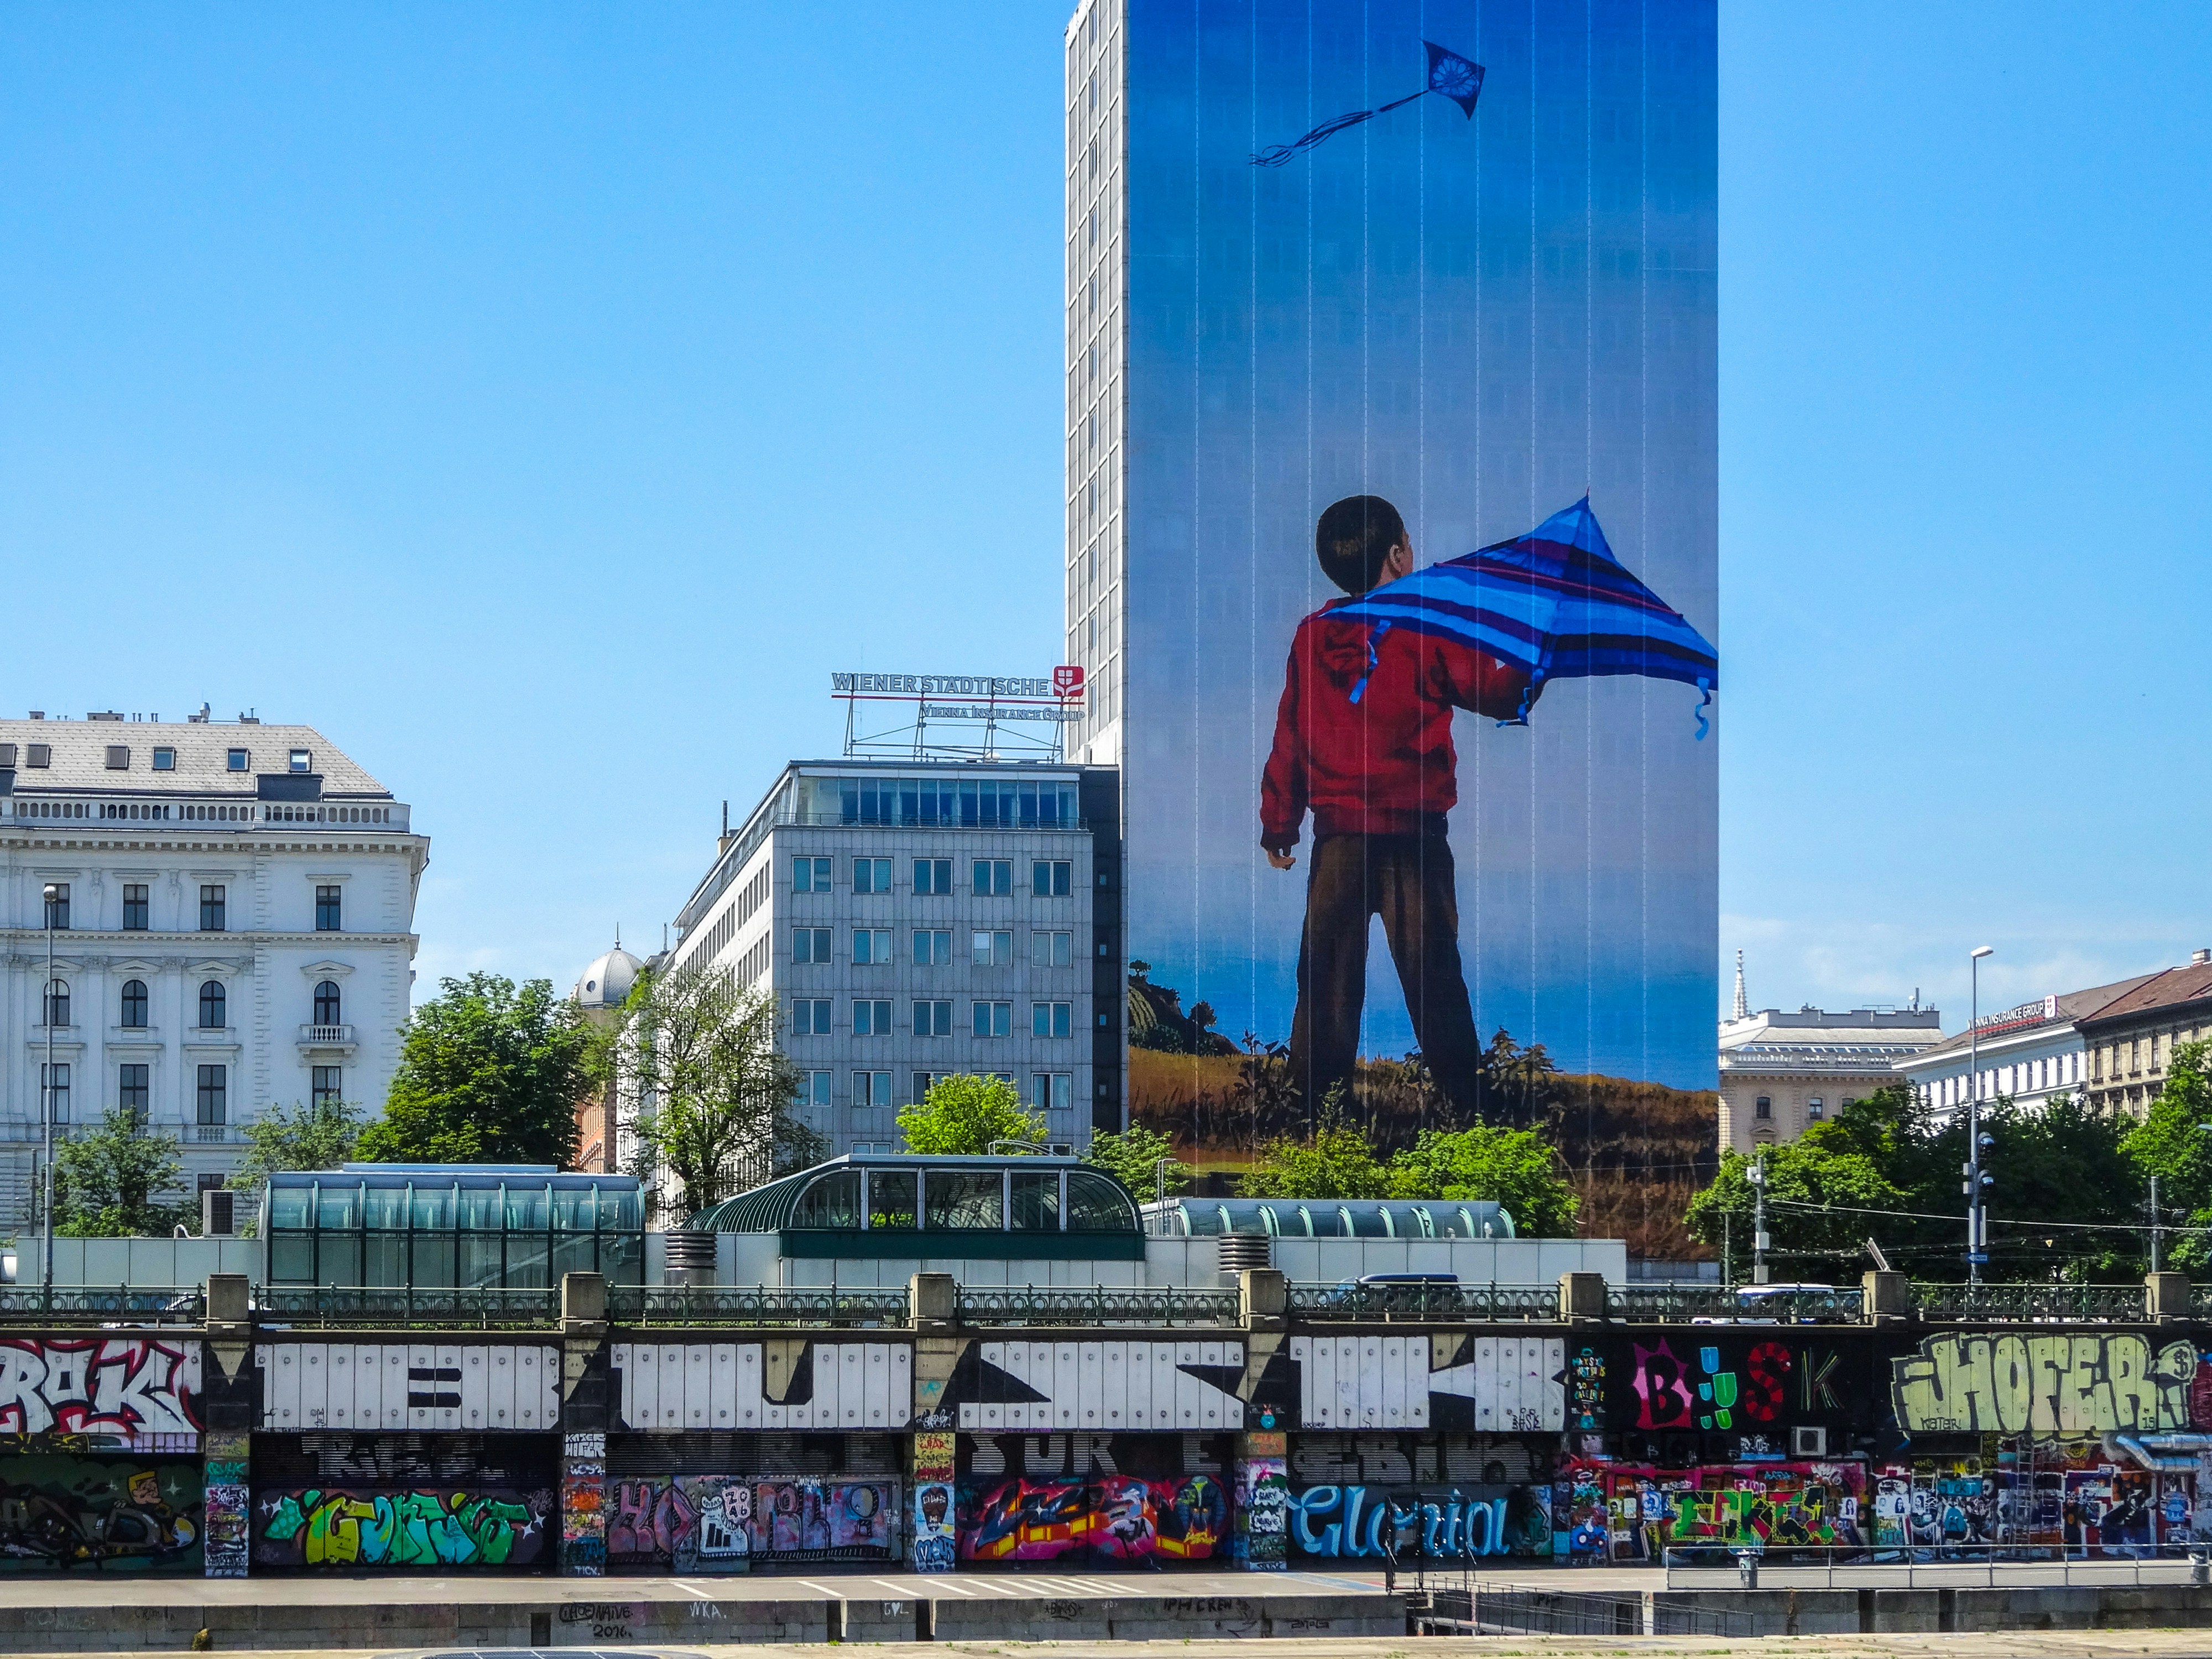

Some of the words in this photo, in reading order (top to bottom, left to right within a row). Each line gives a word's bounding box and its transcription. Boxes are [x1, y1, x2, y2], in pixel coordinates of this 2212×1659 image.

[831, 672, 917, 691] WIENER
[921, 675, 1050, 696] STÄDTISCHE
[1989, 1006, 2022, 1024] INSURANCE
[2023, 1003, 2044, 1018] GROUP
